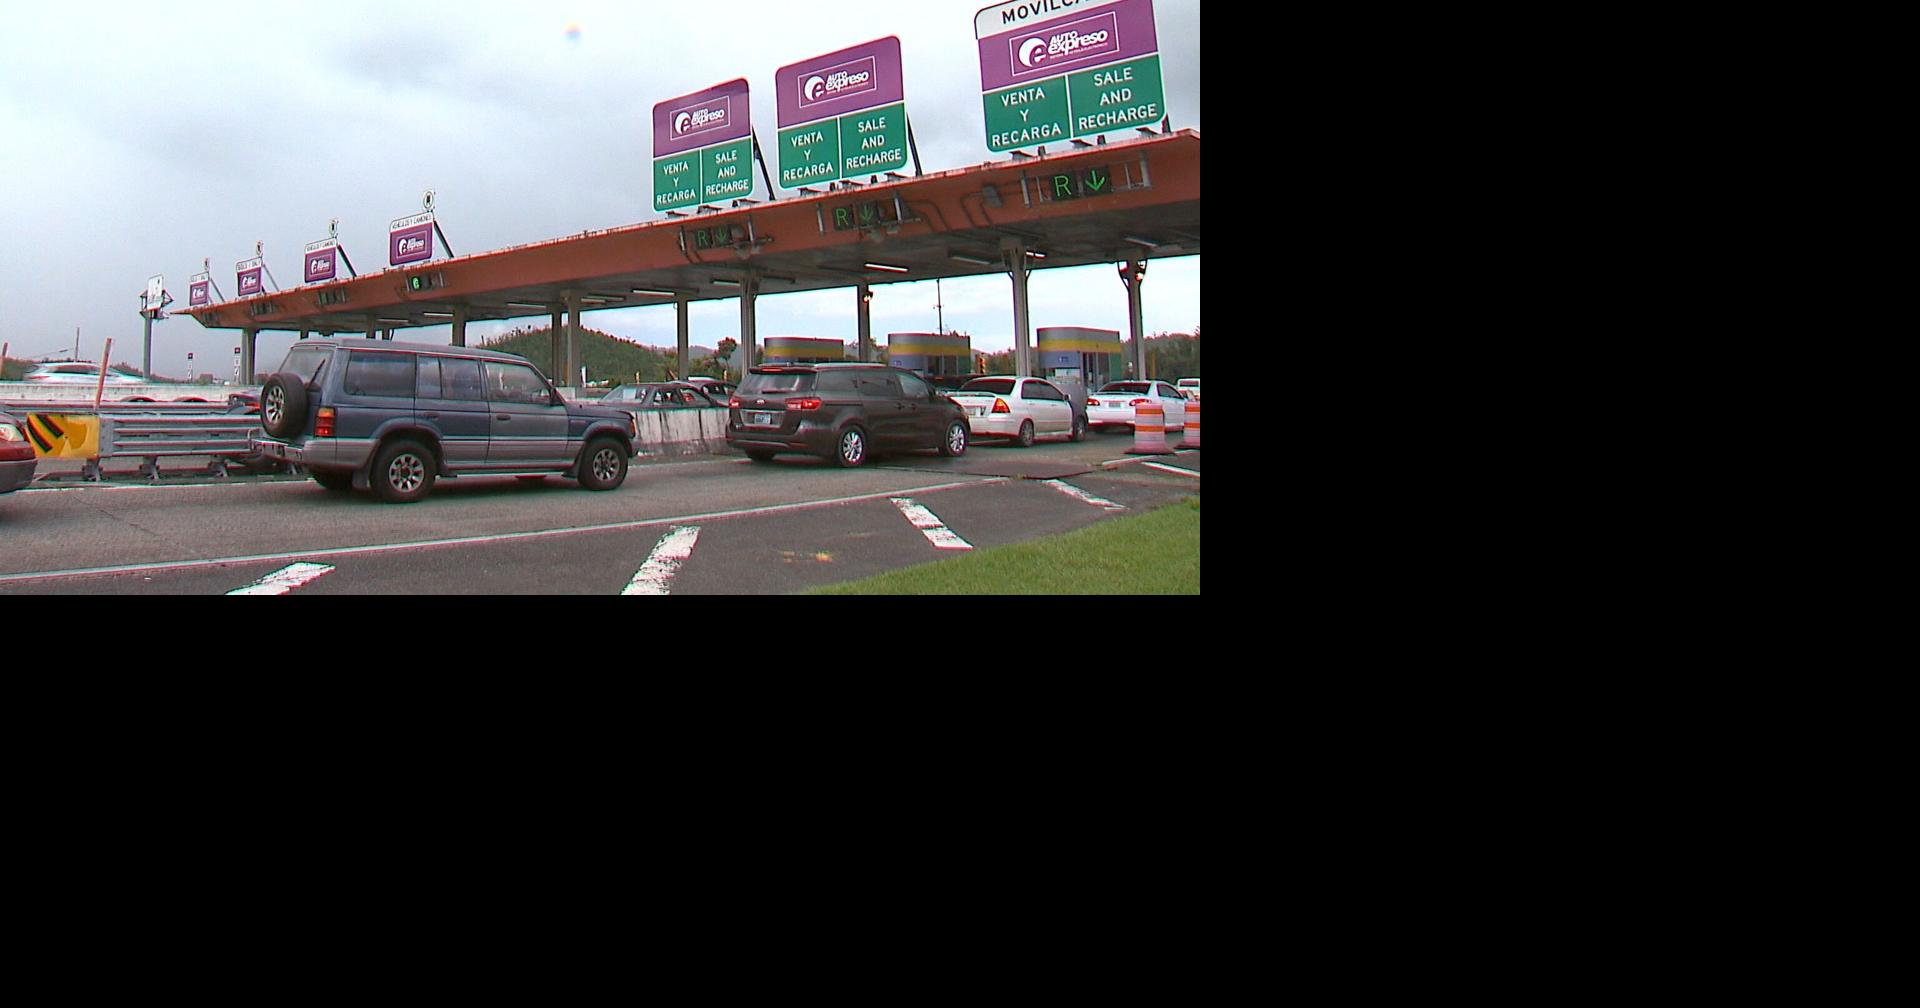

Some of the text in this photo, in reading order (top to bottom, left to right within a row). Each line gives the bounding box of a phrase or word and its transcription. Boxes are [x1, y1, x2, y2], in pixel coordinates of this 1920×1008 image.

[1002, 0, 1088, 24] MOVIL
[1048, 30, 1108, 55] expreso
[1050, 31, 1078, 44] AUTO
[825, 71, 869, 92] expreso
[827, 71, 847, 83] AUTO
[1094, 67, 1133, 87] SALE
[1001, 87, 1045, 107] VENTA
[1099, 88, 1132, 106] AND
[1020, 109, 1029, 122] Y
[1078, 104, 1158, 131] RECHARGE
[858, 117, 886, 133] SALE
[791, 131, 824, 148] VENTA
[861, 134, 885, 150] AND
[992, 122, 1062, 147] RECARGA
[715, 150, 737, 165] SALE
[804, 150, 811, 160] Y
[846, 148, 902, 169] RECHARGE
[663, 161, 689, 175] VENTA
[718, 166, 736, 179] AND
[783, 162, 834, 181] RECARGA
[673, 177, 679, 188] Y
[705, 179, 749, 196] RECHARGE
[1054, 175, 1072, 197] R
[656, 189, 696, 205] RECARGA
[835, 208, 849, 226] R
[697, 230, 709, 245] R
